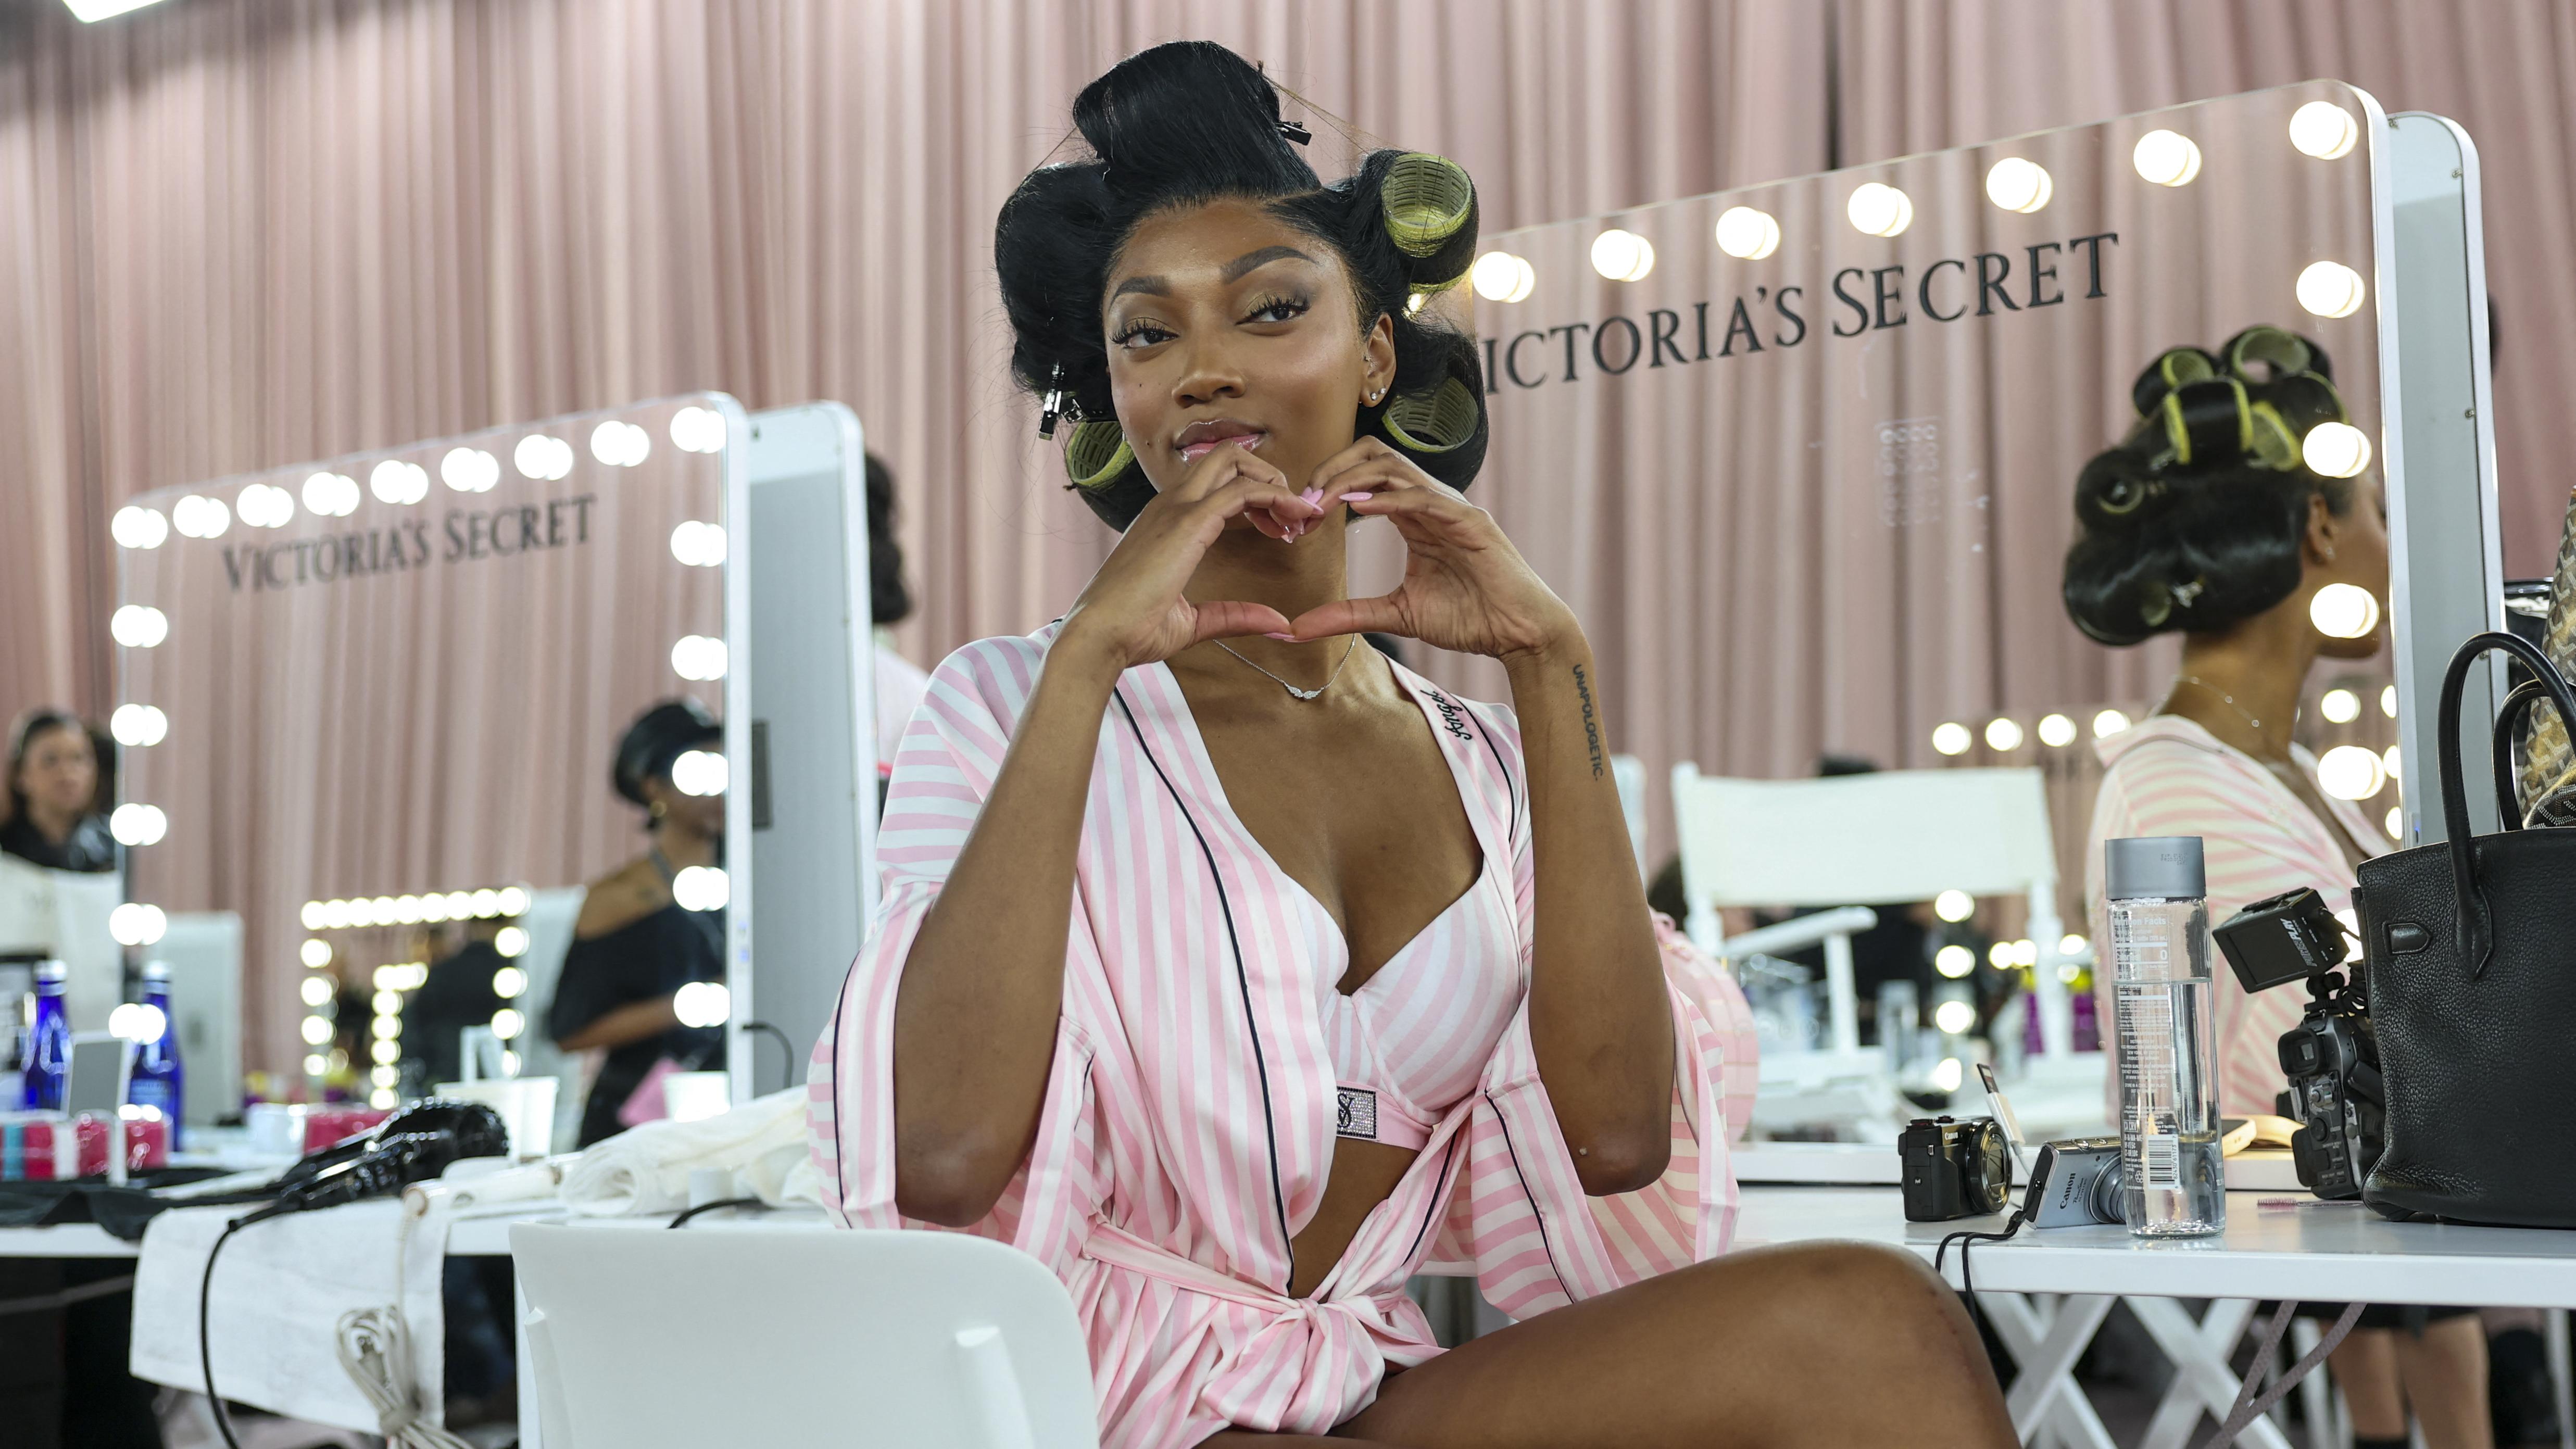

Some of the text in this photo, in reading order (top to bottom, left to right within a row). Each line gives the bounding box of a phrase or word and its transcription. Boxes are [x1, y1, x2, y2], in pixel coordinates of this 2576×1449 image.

[1480, 232, 2119, 395] ICTORIA'S SECRET
[221, 493, 596, 593] VICTORIA'S SECRET
[1420, 689, 1472, 741] Angel
[2144, 917, 2167, 925] Facts
[1945, 1132, 1958, 1140] Canon
[2060, 1172, 2076, 1210] Canon
